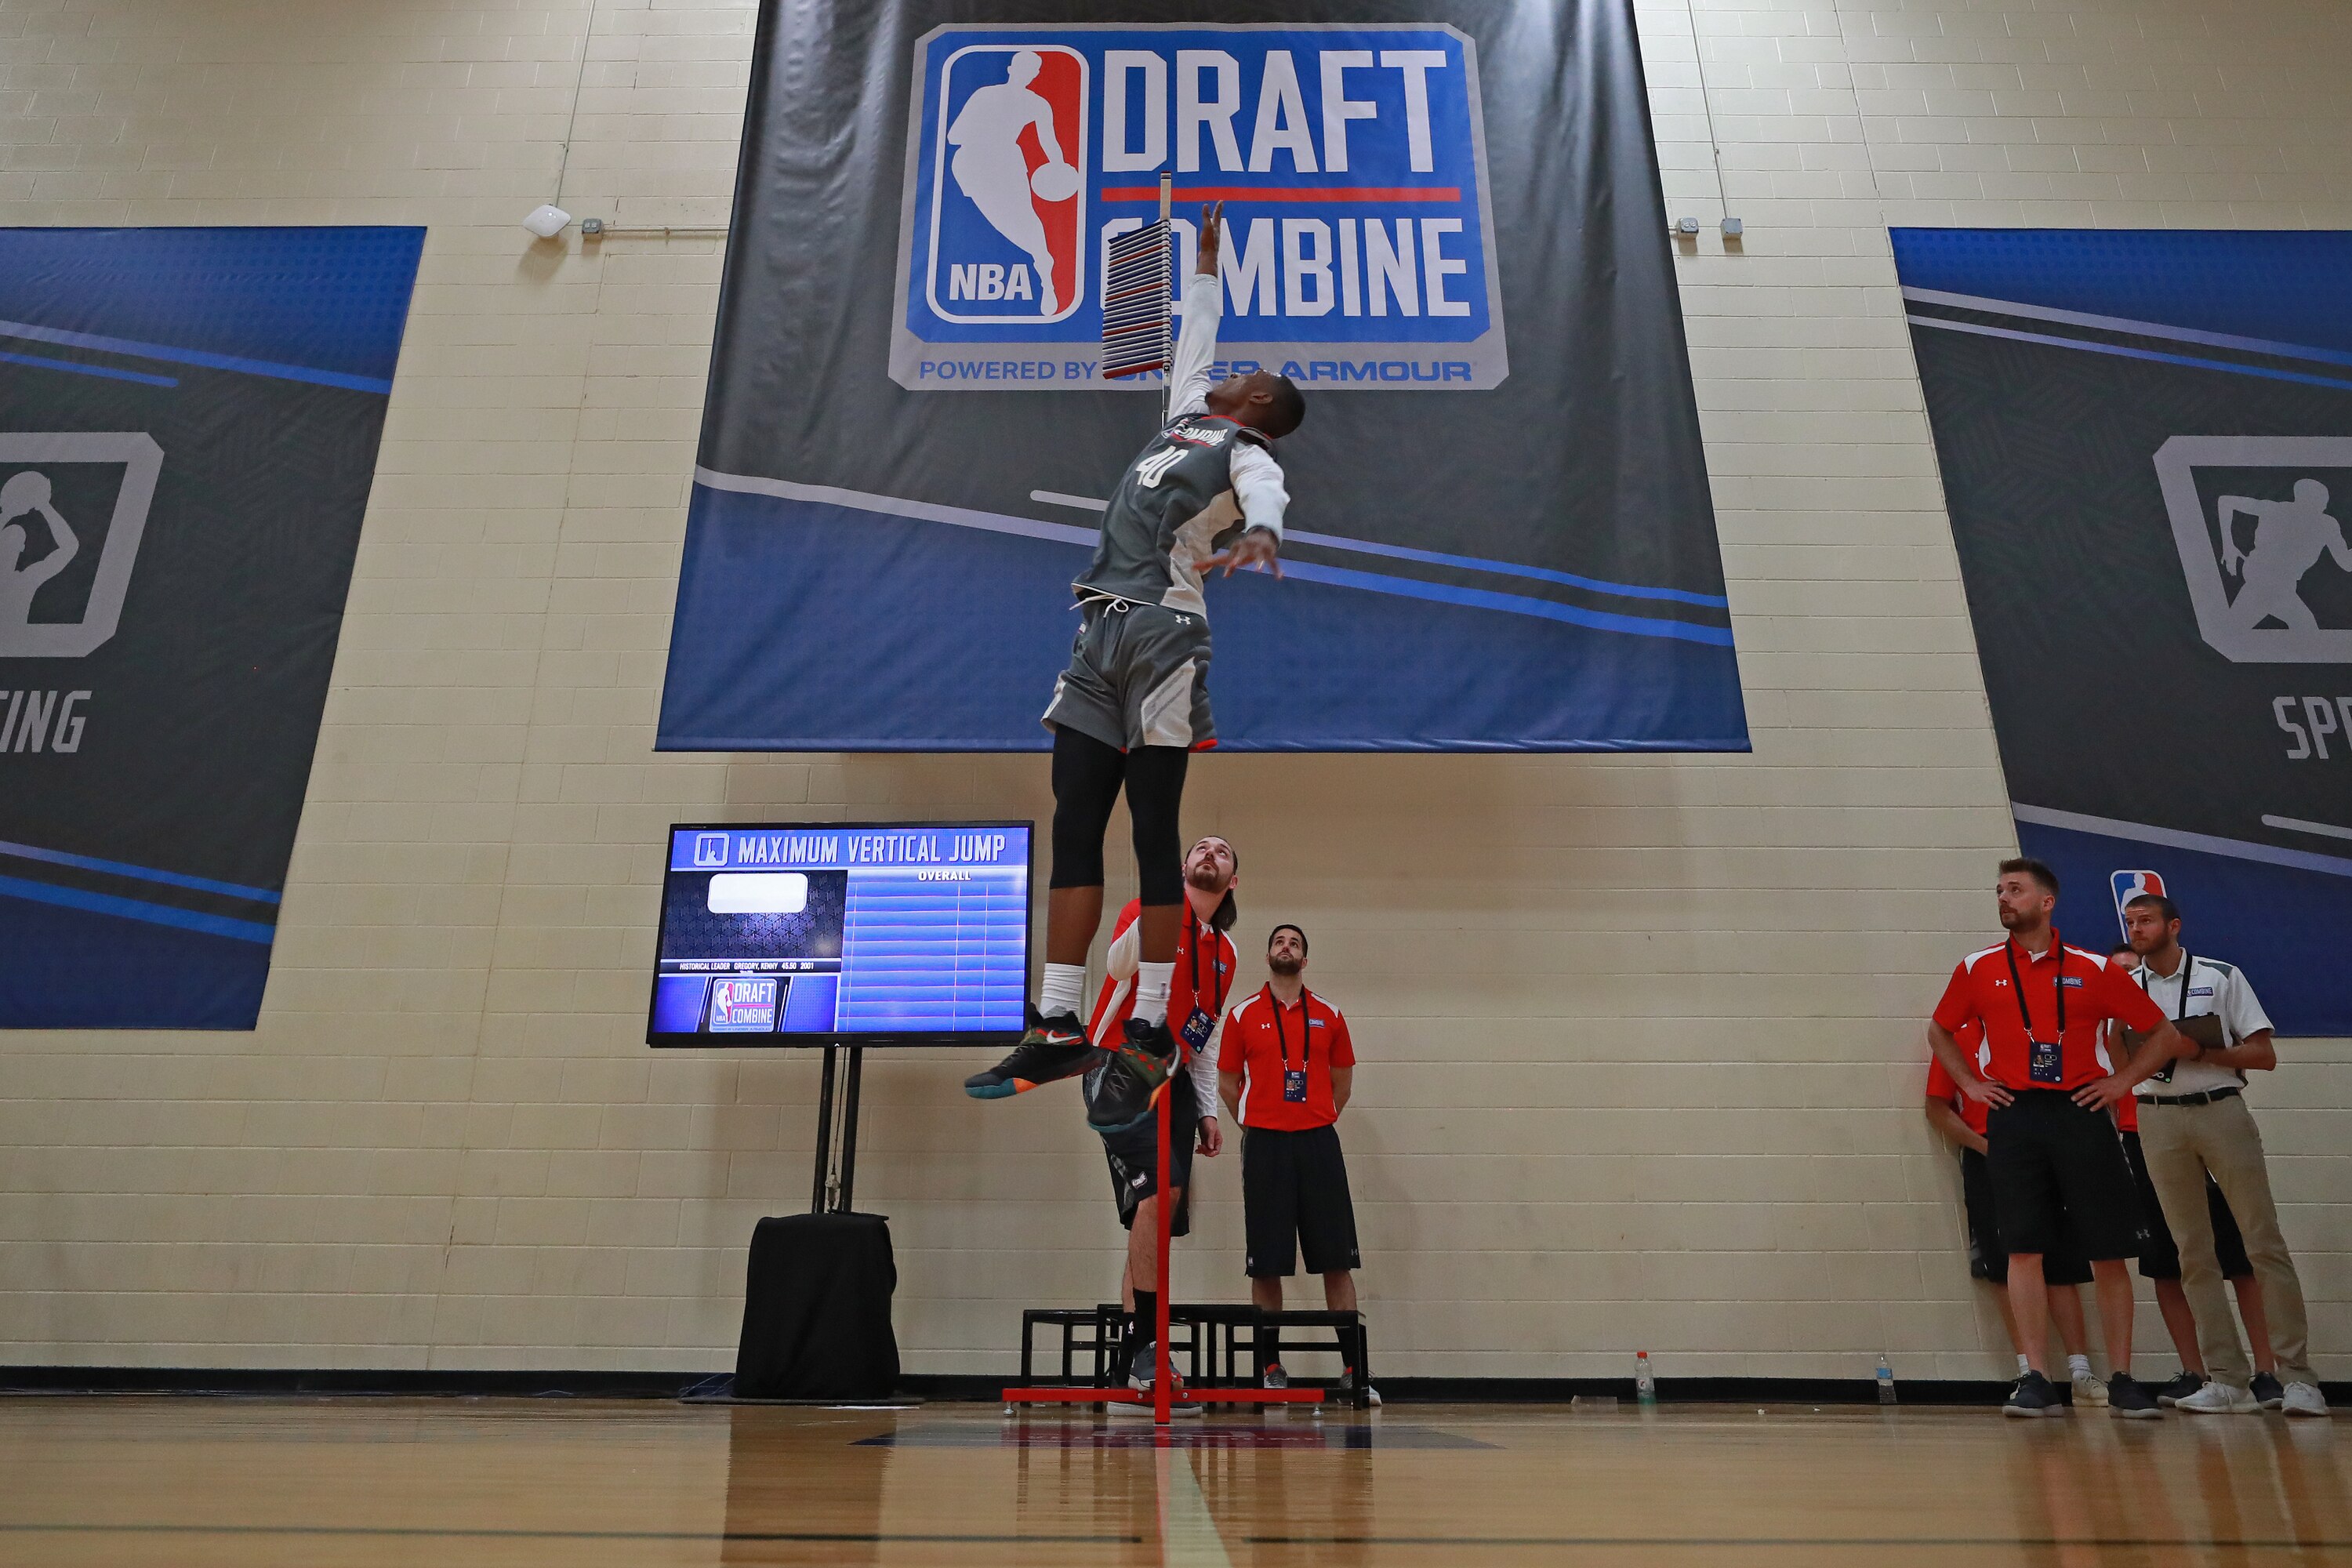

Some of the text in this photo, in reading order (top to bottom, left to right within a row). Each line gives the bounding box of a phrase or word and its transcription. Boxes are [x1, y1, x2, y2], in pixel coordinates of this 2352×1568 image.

[1102, 49, 1446, 172] DRAFT
[949, 263, 1033, 301] NBA
[920, 361, 1056, 379] POWERED
[1064, 361, 1098, 379] BY
[1279, 361, 1472, 381] ARMOUR
[1135, 445, 1189, 489] 40
[0, 690, 93, 753] ING
[738, 835, 1006, 863] MAXIMUM VERTICAL JUMP
[917, 870, 972, 881] OVERALL
[734, 983, 775, 1002] DRAFT
[732, 1009, 772, 1023] COMBINE
